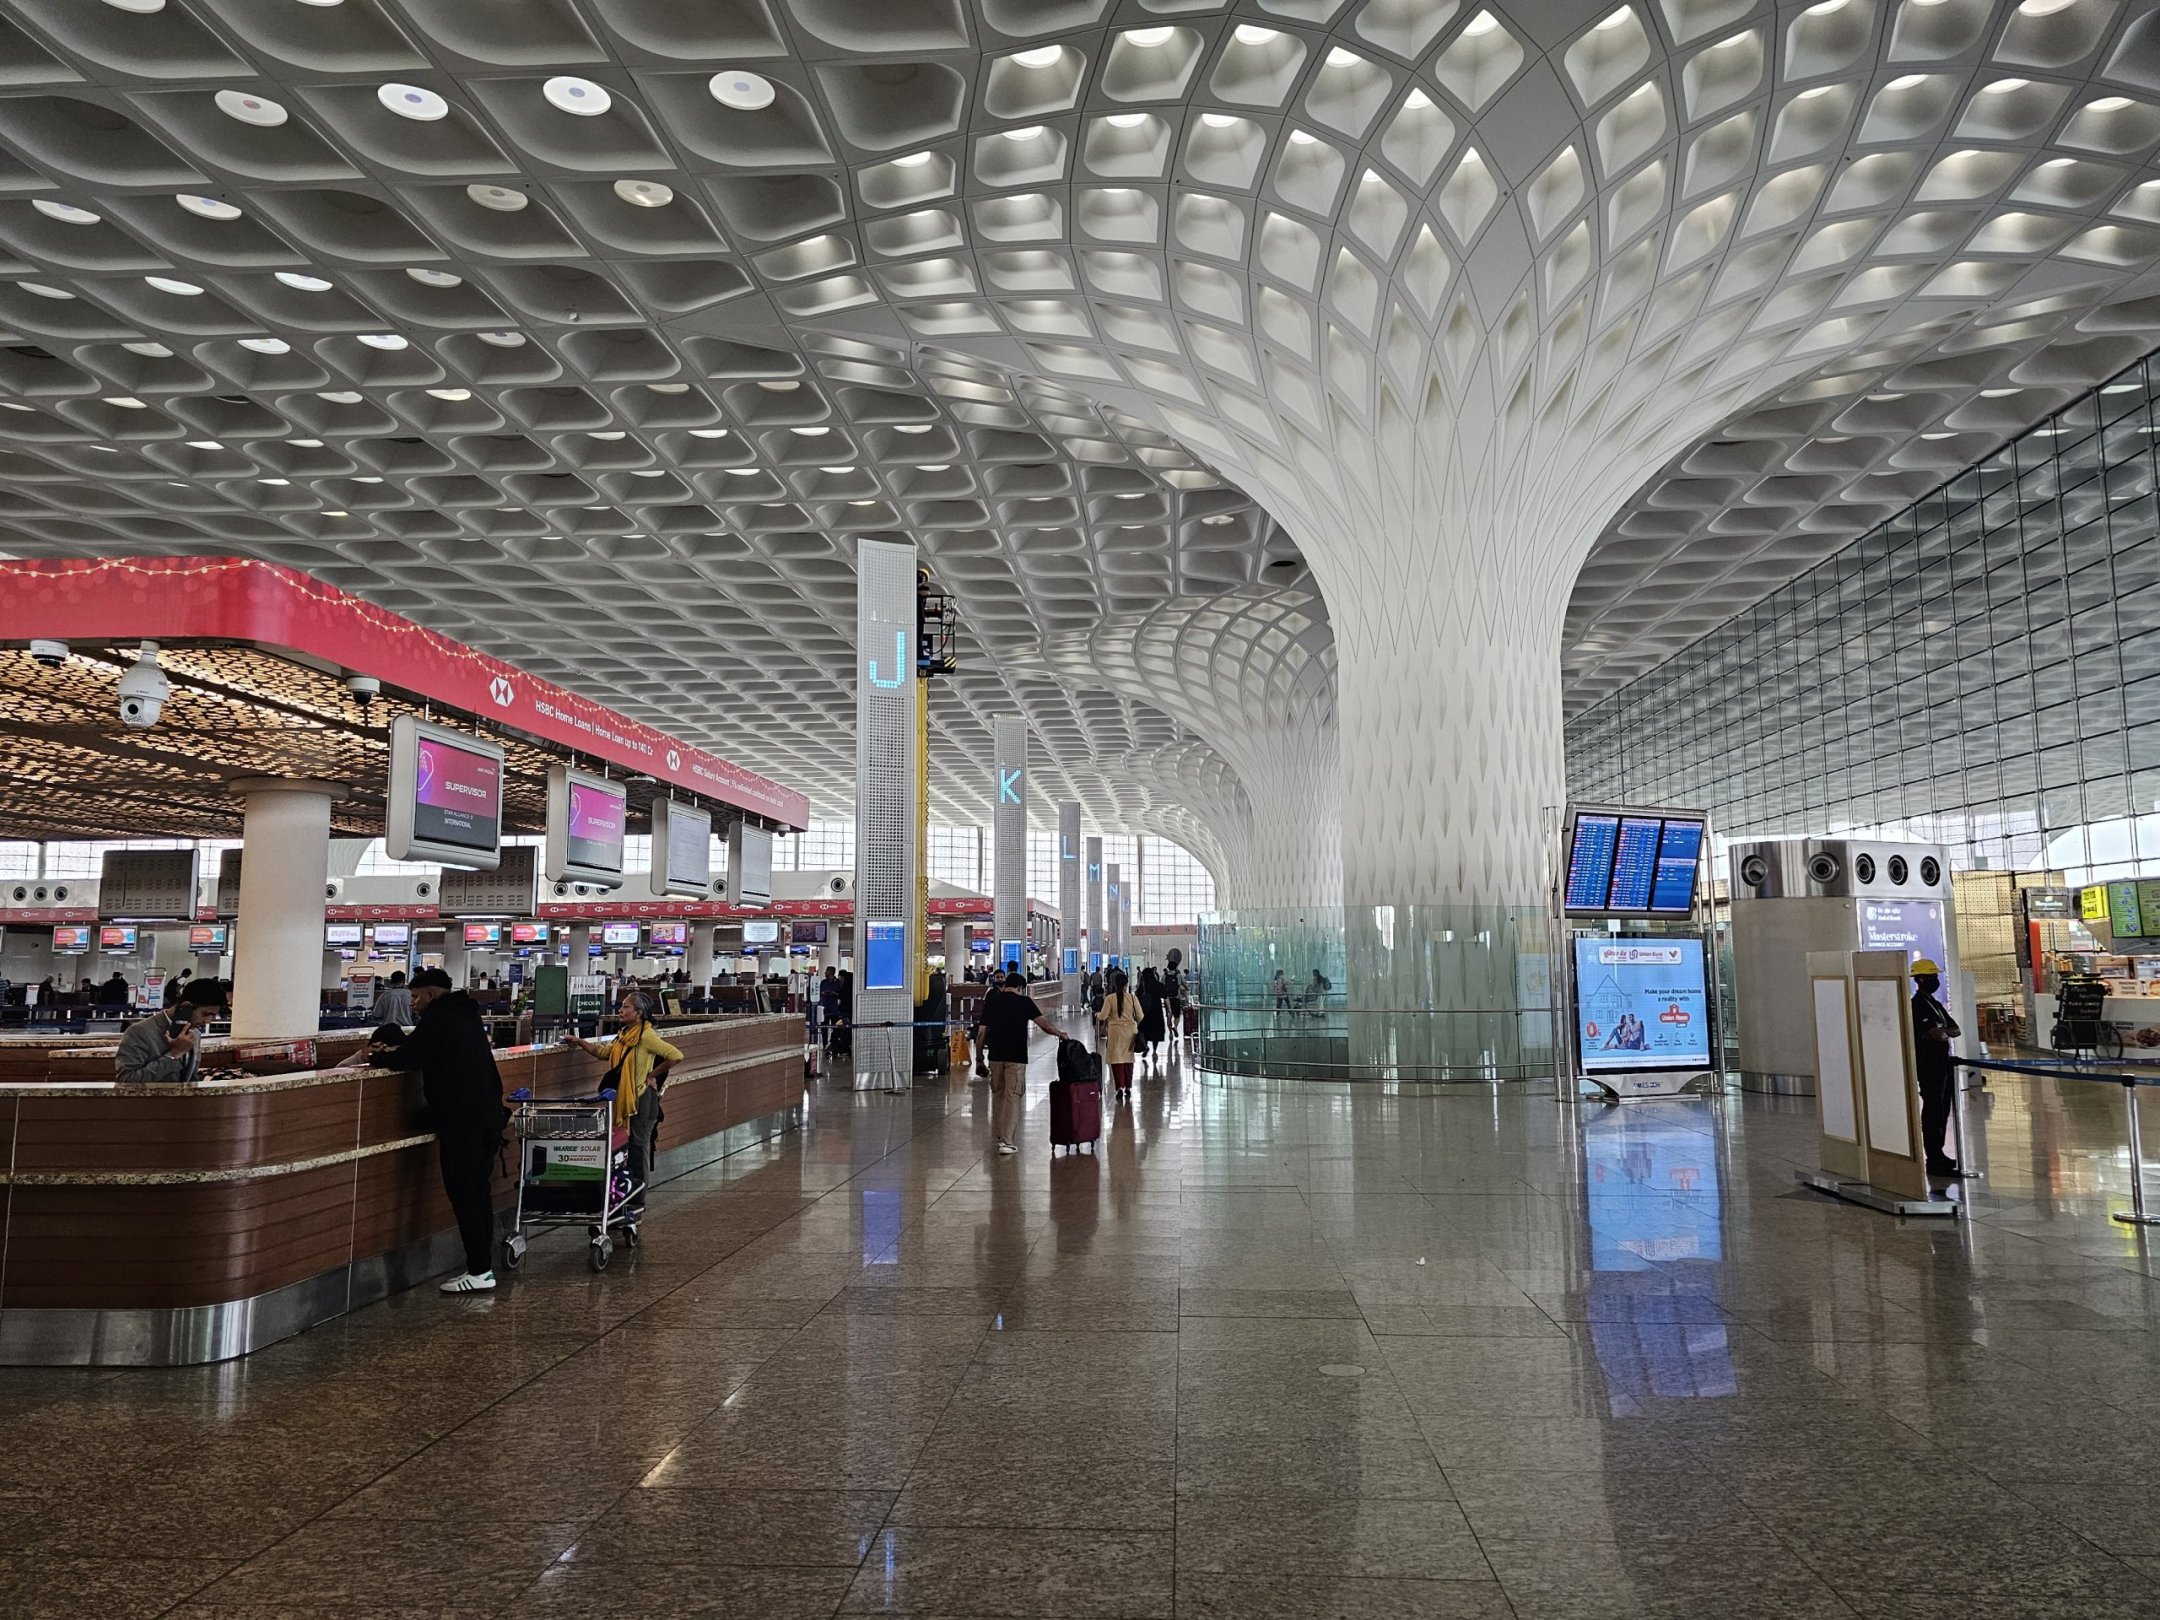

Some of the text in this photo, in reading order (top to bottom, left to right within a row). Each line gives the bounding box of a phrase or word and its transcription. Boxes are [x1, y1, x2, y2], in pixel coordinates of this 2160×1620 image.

[870, 631, 905, 688] J
[535, 700, 554, 717] HSBC
[555, 706, 573, 725] Home
[574, 715, 592, 732] Loans
[595, 724, 611, 738] Home
[611, 733, 624, 745] Loan
[624, 740, 632, 749] up
[632, 740, 638, 750] to
[445, 781, 487, 799] SUPERVISOR
[1000, 768, 1021, 804] K
[588, 816, 616, 830] SUPERVISOR
[1063, 835, 1077, 859] L
[1089, 863, 1100, 882] M
[1109, 884, 1118, 900] N
[1868, 931, 1918, 942] Masterstroke
[577, 1008, 600, 1016] Economy
[558, 1154, 570, 1163] 30
